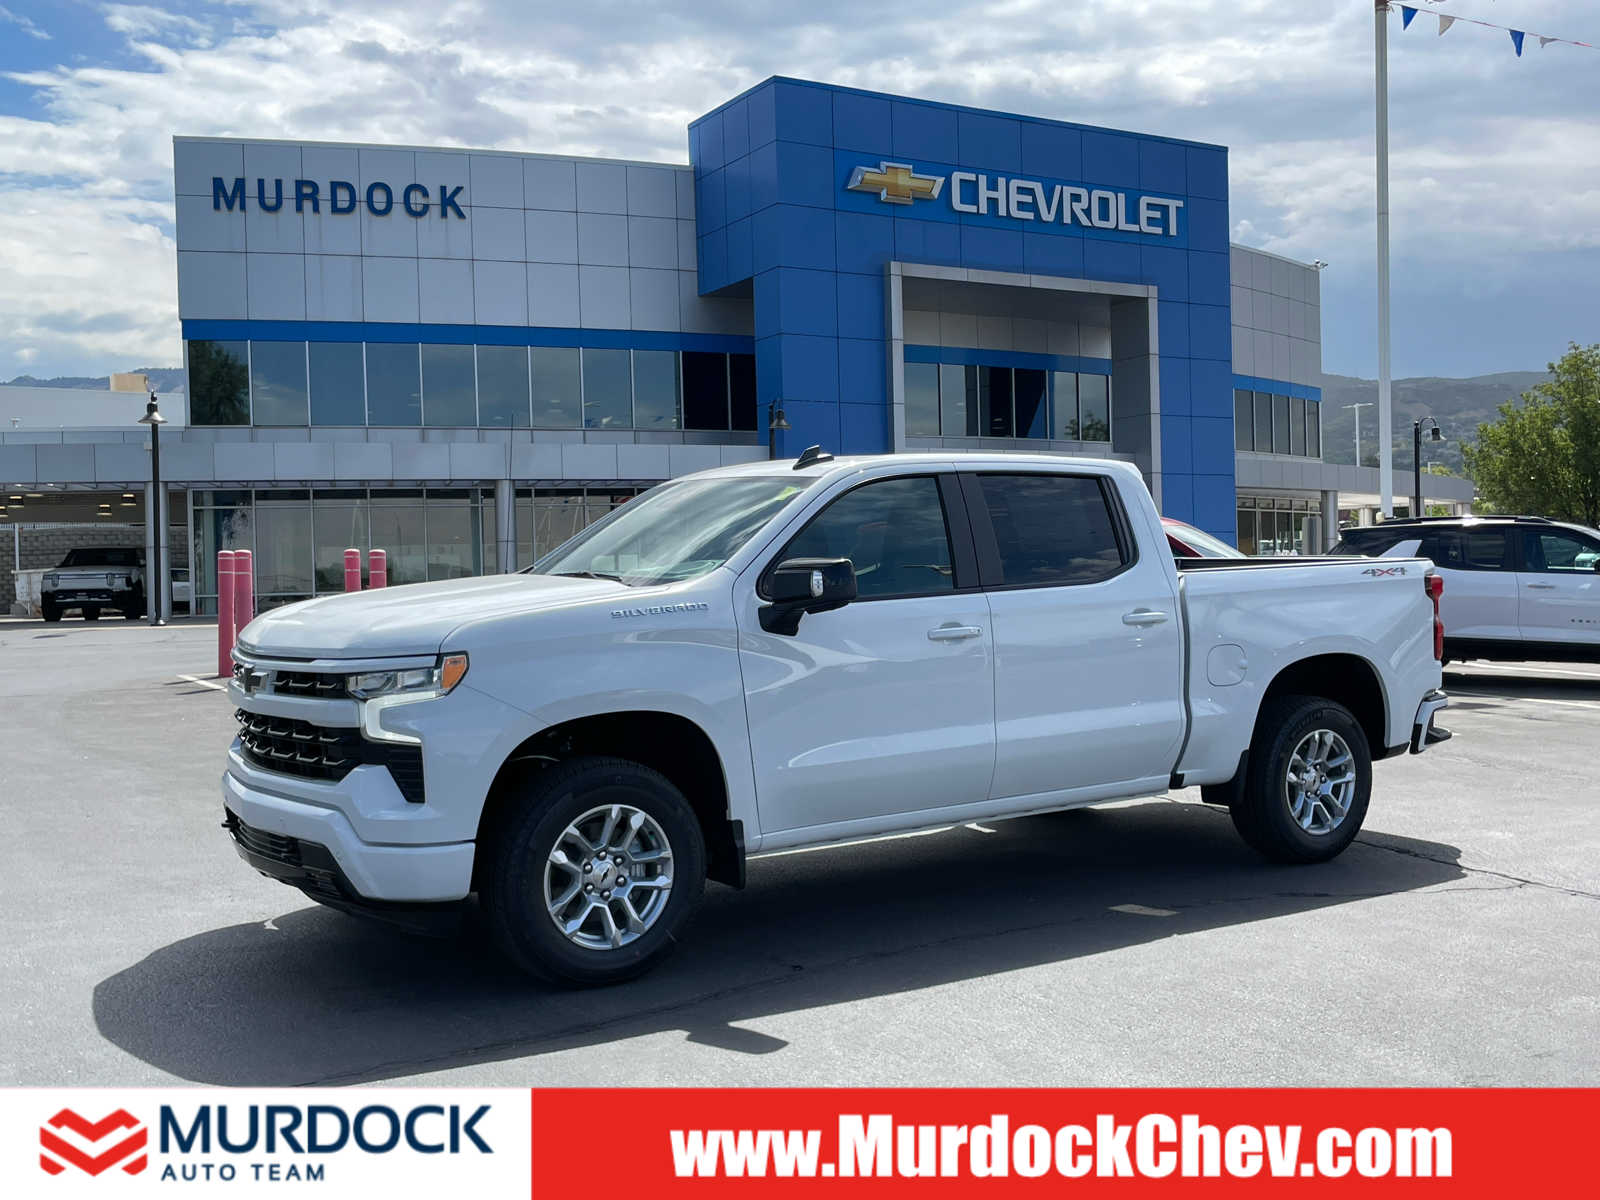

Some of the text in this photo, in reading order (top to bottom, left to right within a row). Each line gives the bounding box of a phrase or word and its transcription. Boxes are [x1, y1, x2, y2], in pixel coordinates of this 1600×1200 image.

[212, 176, 467, 220] MURDOCK
[951, 171, 1184, 236] CHEVROLET
[609, 602, 709, 619] SILVERADO
